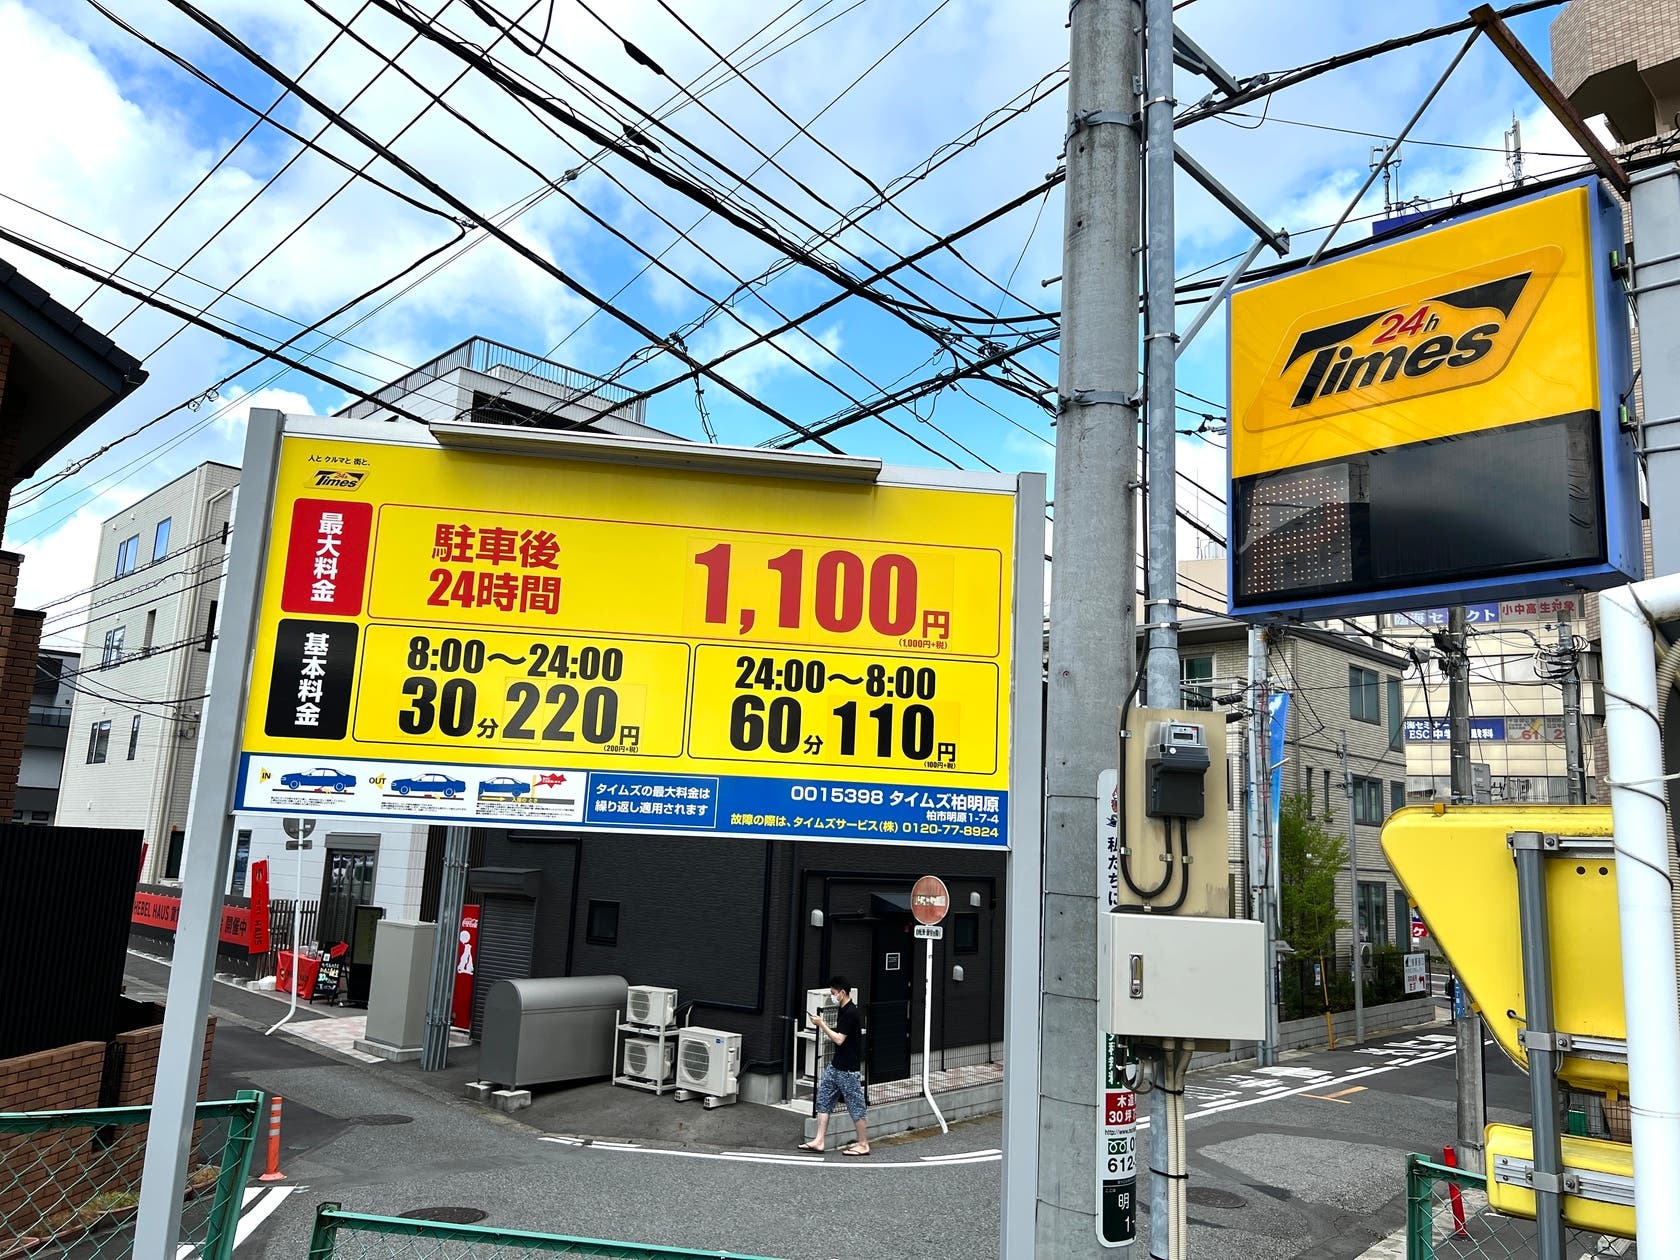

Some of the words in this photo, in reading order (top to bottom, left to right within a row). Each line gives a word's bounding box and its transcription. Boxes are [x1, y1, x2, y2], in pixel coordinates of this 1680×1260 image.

[1373, 306, 1439, 345] 24h
[1286, 322, 1501, 409] Times
[325, 456, 351, 465] クルマと
[314, 474, 358, 488] Times
[432, 524, 560, 570] 駐車後
[310, 512, 344, 602] 最大料金
[427, 568, 561, 615] 24時間
[1394, 608, 1496, 626] 臨海セクト
[295, 632, 329, 726] 基本料金
[1409, 730, 1430, 739] ESC
[262, 772, 271, 780] IN
[369, 777, 386, 785] OUT
[596, 783, 711, 800] タイムズの最大料金は
[790, 785, 883, 805] 0015398
[889, 790, 999, 812] タイムズ柏明原
[594, 799, 709, 816] 繰り返し適用されます
[926, 810, 999, 824] 柏市明原1-7-4
[153, 904, 170, 921] HAUS
[1118, 1192, 1129, 1210] 明
